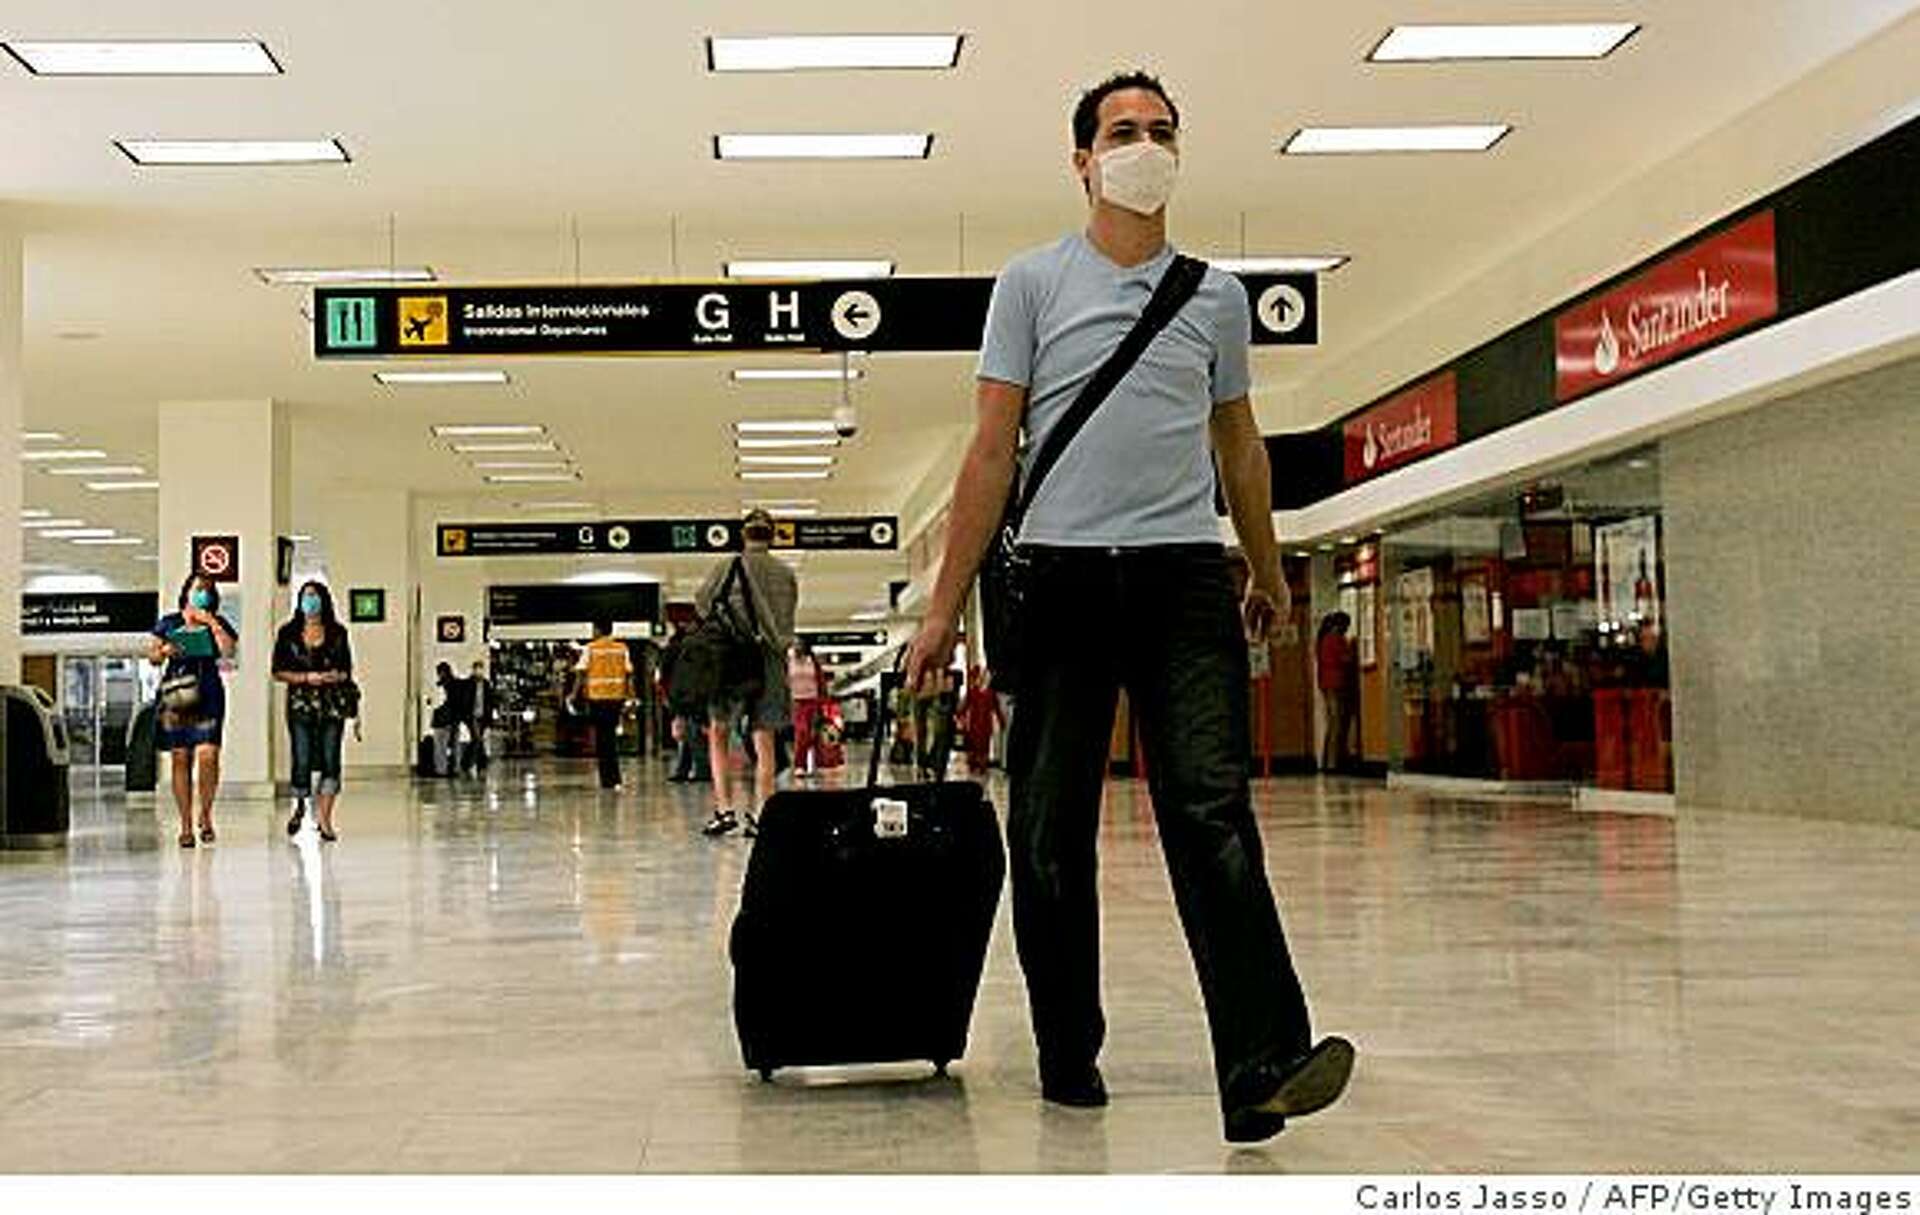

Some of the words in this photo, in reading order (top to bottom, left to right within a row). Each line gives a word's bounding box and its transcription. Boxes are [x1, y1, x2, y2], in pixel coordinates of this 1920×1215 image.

[463, 304, 523, 318] Salidas
[526, 304, 650, 318] Internacionales
[695, 292, 730, 330] G
[769, 290, 800, 329] H
[1627, 267, 1730, 359] Santander
